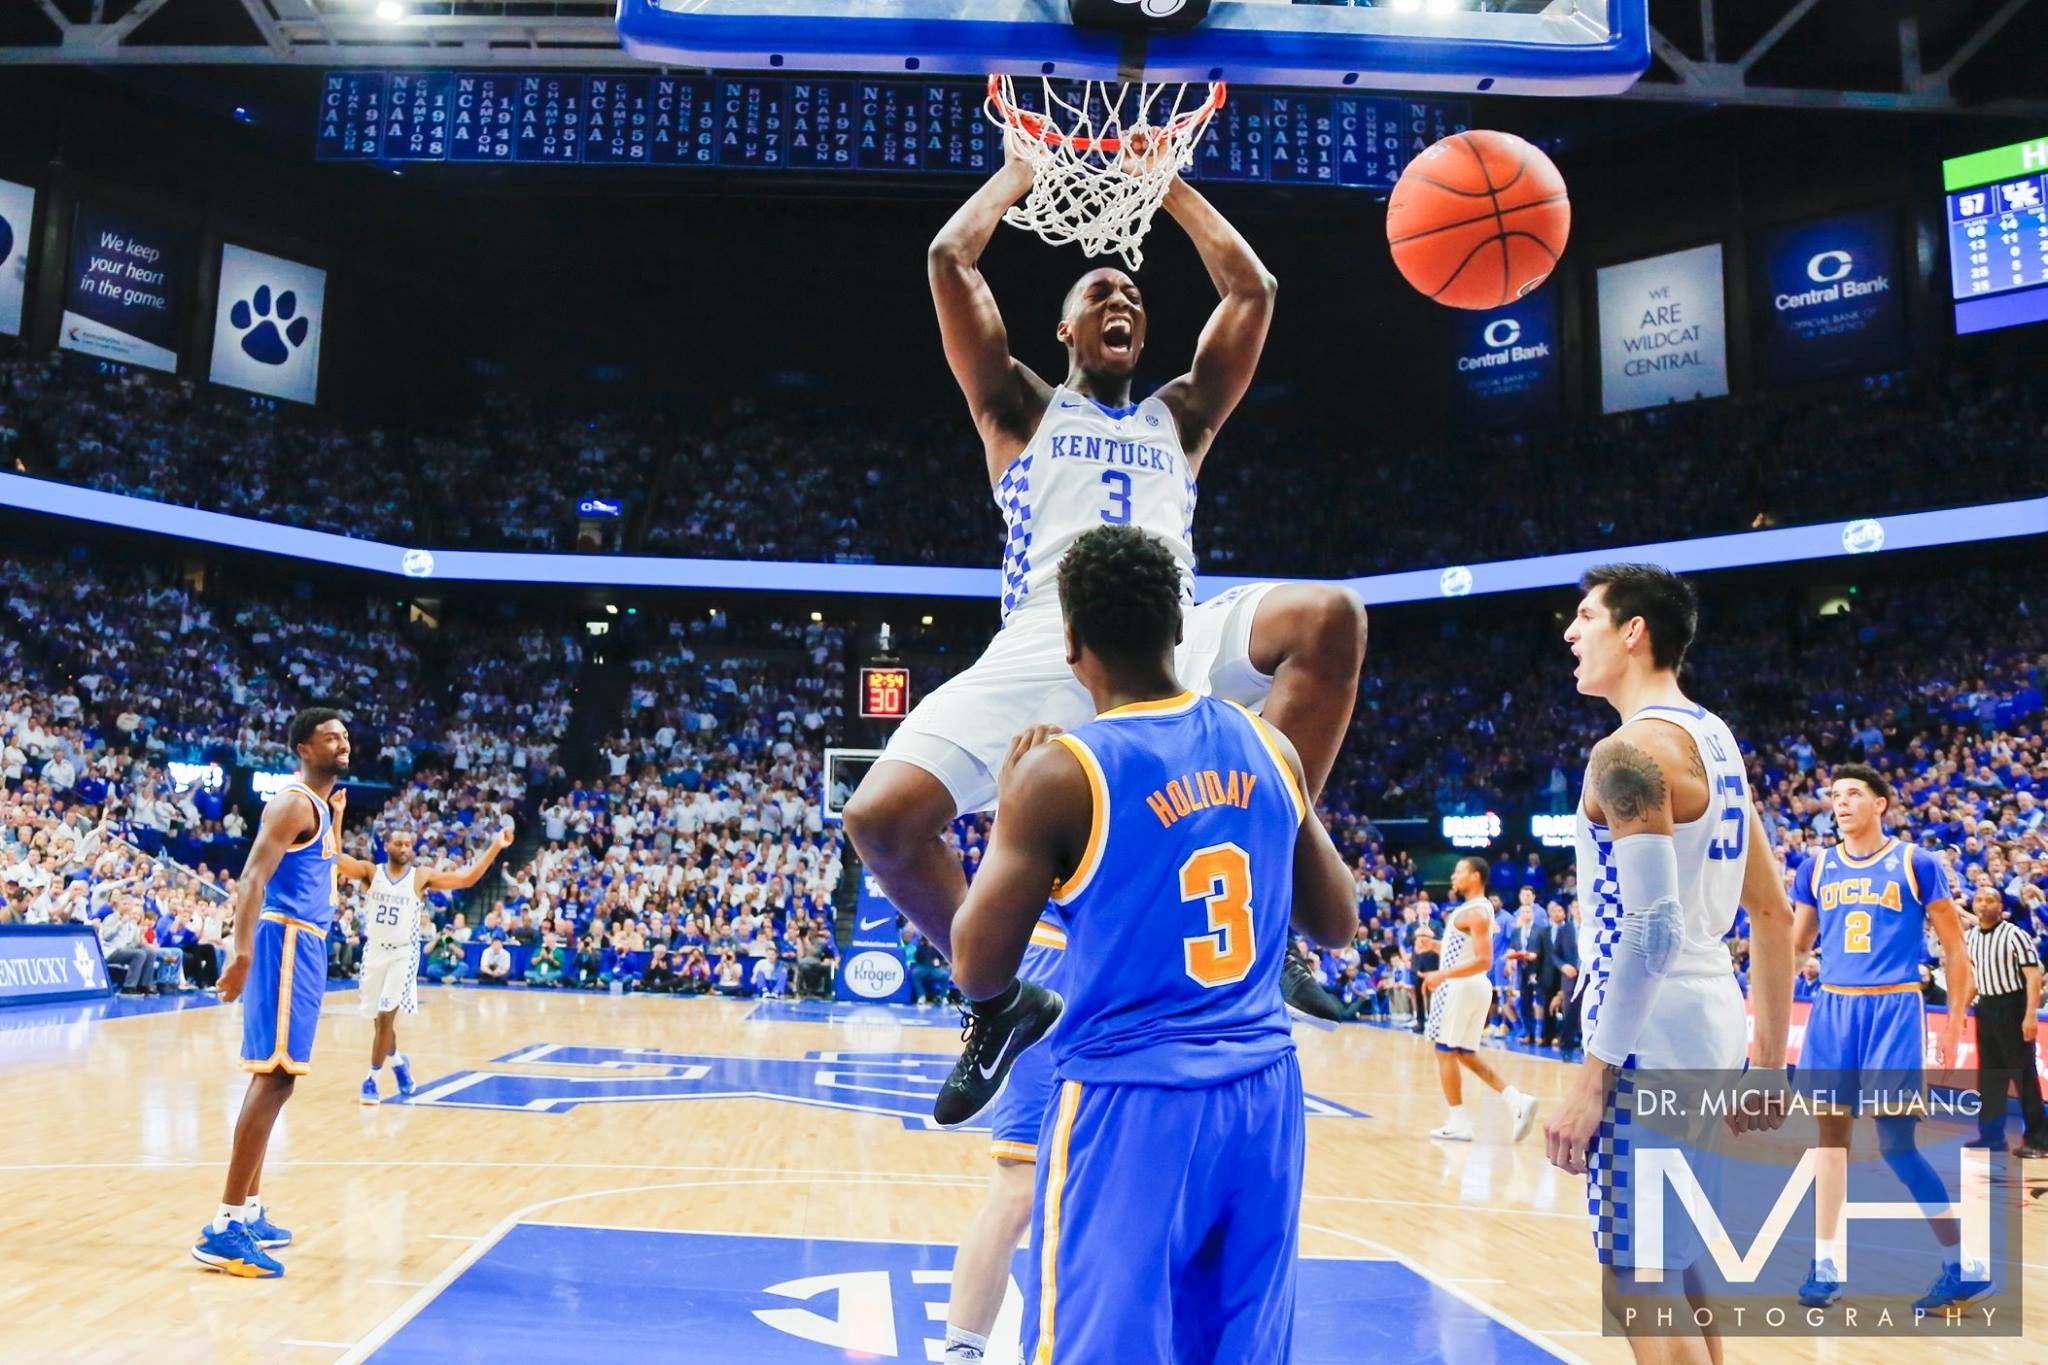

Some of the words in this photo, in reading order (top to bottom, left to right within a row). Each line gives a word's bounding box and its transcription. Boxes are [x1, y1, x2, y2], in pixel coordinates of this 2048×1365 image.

[324, 78, 343, 137] NCAA
[362, 93, 378, 152] 1942
[388, 76, 408, 136] NCAA
[410, 80, 427, 151] CHAMPION
[429, 94, 445, 154] 1948
[455, 79, 475, 139] NCAA
[478, 81, 494, 153] CHAMPION
[495, 98, 511, 156] 1949
[521, 78, 540, 138] NCAA
[543, 82, 559, 154] CHAMPION
[563, 98, 577, 157] 1951
[588, 81, 607, 141] NCAA
[612, 83, 627, 155] CHAMPION
[630, 98, 645, 158] 1958
[655, 81, 675, 142] NCAA
[697, 102, 712, 161] 1966
[724, 84, 742, 145] NCAA
[764, 102, 780, 161] 1975
[793, 86, 810, 146] NCAA
[816, 88, 830, 160] CHAMPION
[835, 102, 849, 162] 1978
[862, 87, 879, 149] NCAA
[928, 88, 944, 149] NCAA
[1273, 99, 1288, 160] NCAA
[1342, 102, 1357, 163] NCAA
[903, 106, 917, 166] 1984
[970, 107, 984, 167] 1993
[1248, 115, 1262, 176] 2011
[1317, 118, 1331, 178] 2012
[1384, 122, 1398, 182] 2014
[2022, 141, 2048, 169] H
[1959, 192, 1985, 216] 57
[2000, 218, 2019, 231] 14
[100, 231, 124, 251] We
[126, 239, 160, 263] keep
[2001, 232, 2019, 245] 11
[80, 274, 95, 292] in
[98, 279, 122, 299] the
[89, 256, 123, 275] your
[126, 261, 164, 285] heart
[1649, 286, 1671, 300] WE
[1775, 284, 1839, 311] Central
[1843, 275, 1889, 298] Bank
[1623, 325, 1701, 352] WILDCAT
[1640, 303, 1681, 329] ARE
[1458, 349, 1509, 371] Central
[1511, 342, 1549, 362] Bank
[1624, 350, 1704, 377] CENTRAL
[1052, 435, 1174, 475] KENTUCKY
[1100, 469, 1131, 525] 3
[869, 672, 904, 688] 12:54
[869, 688, 899, 713] 30
[1146, 769, 1257, 829] HOLIDAY
[371, 891, 410, 906] KENTUCKY
[376, 905, 399, 925] 25
[1178, 841, 1257, 988] 3
[1820, 878, 1902, 912] UCLA
[1844, 911, 1871, 953] 2
[854, 959, 897, 991] Kroger
